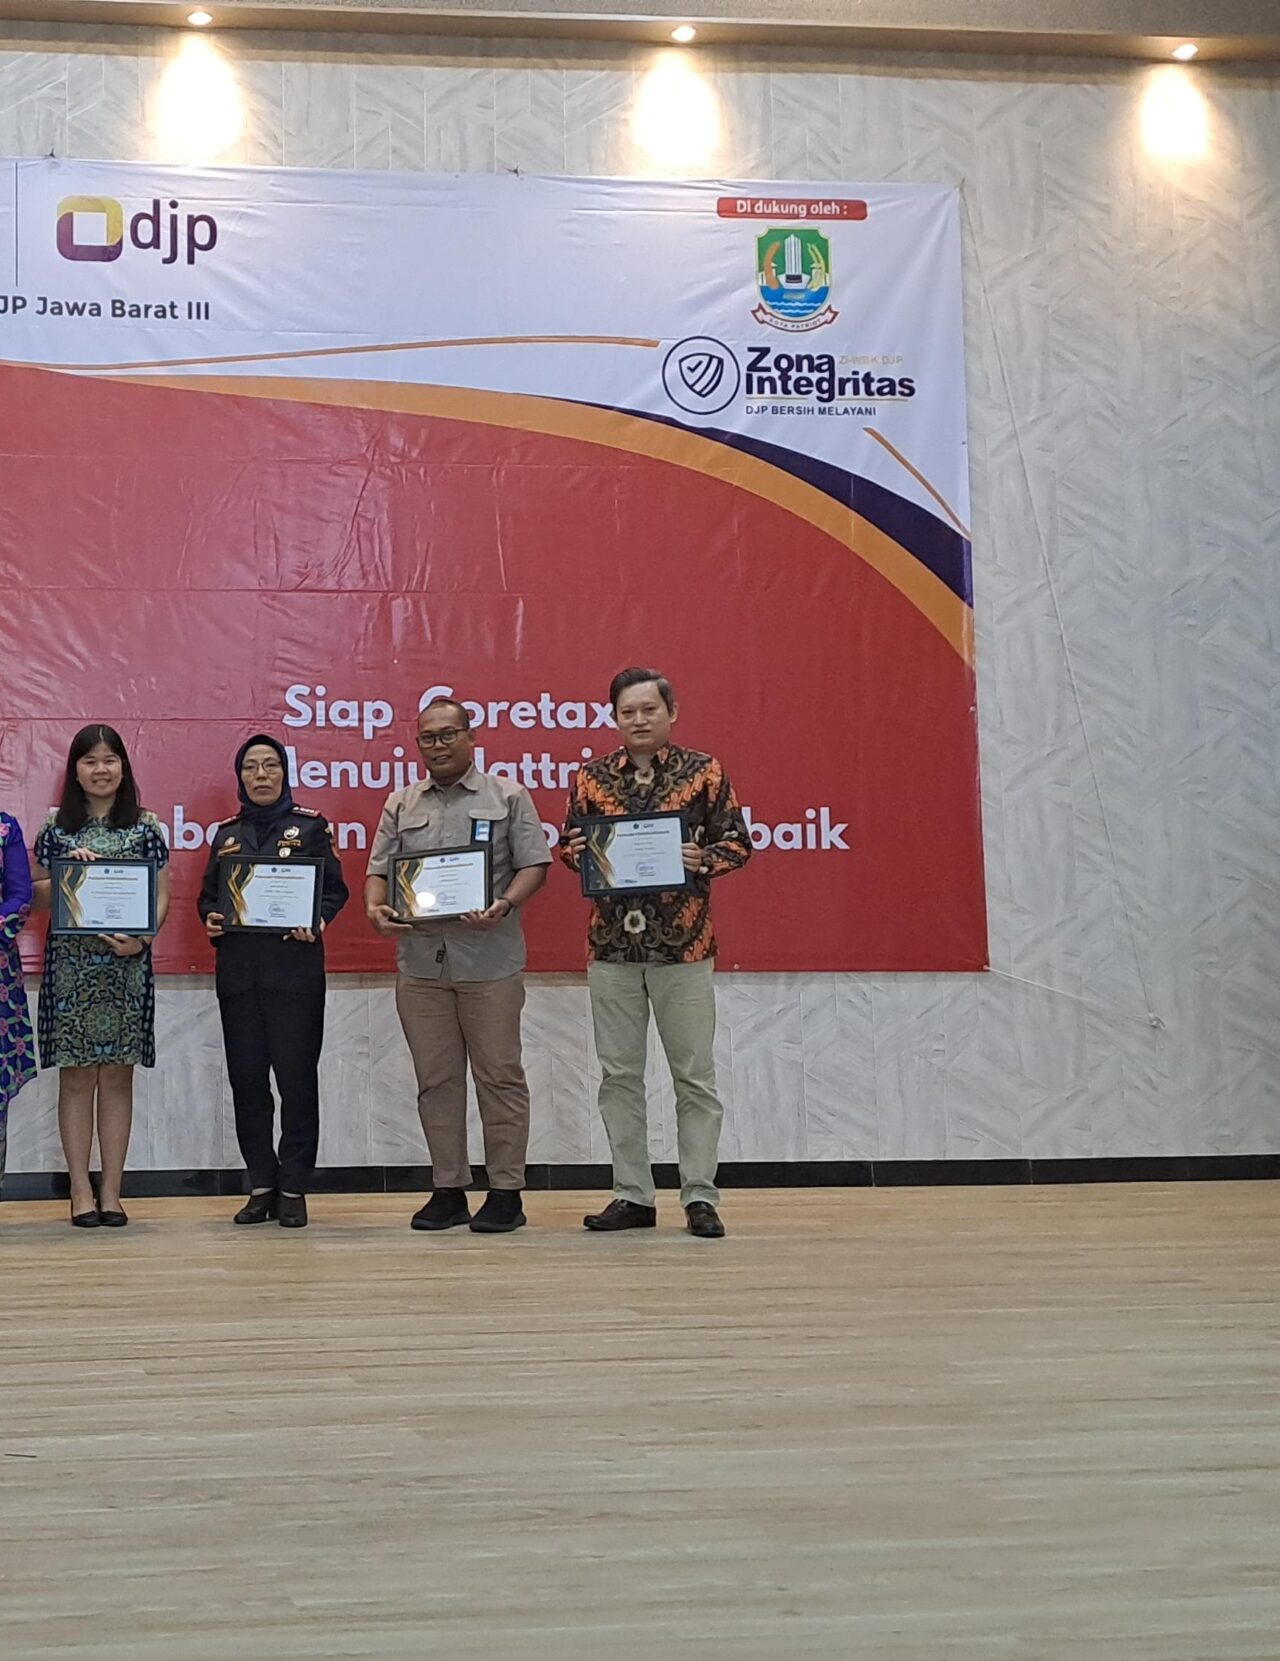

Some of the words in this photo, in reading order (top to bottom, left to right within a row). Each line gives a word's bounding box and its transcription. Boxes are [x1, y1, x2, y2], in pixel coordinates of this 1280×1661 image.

[754, 200, 807, 217] dukung
[810, 201, 841, 215] oleh
[129, 199, 218, 265] djp
[36, 297, 102, 317] Jawa
[111, 299, 179, 319] Barat
[187, 301, 210, 320] III
[746, 346, 835, 373] Zona
[745, 370, 916, 403] Integritas
[746, 405, 768, 415] DJP
[771, 406, 815, 416] BERSIH
[818, 406, 877, 416] MELAYANI
[282, 684, 394, 740] Siap
